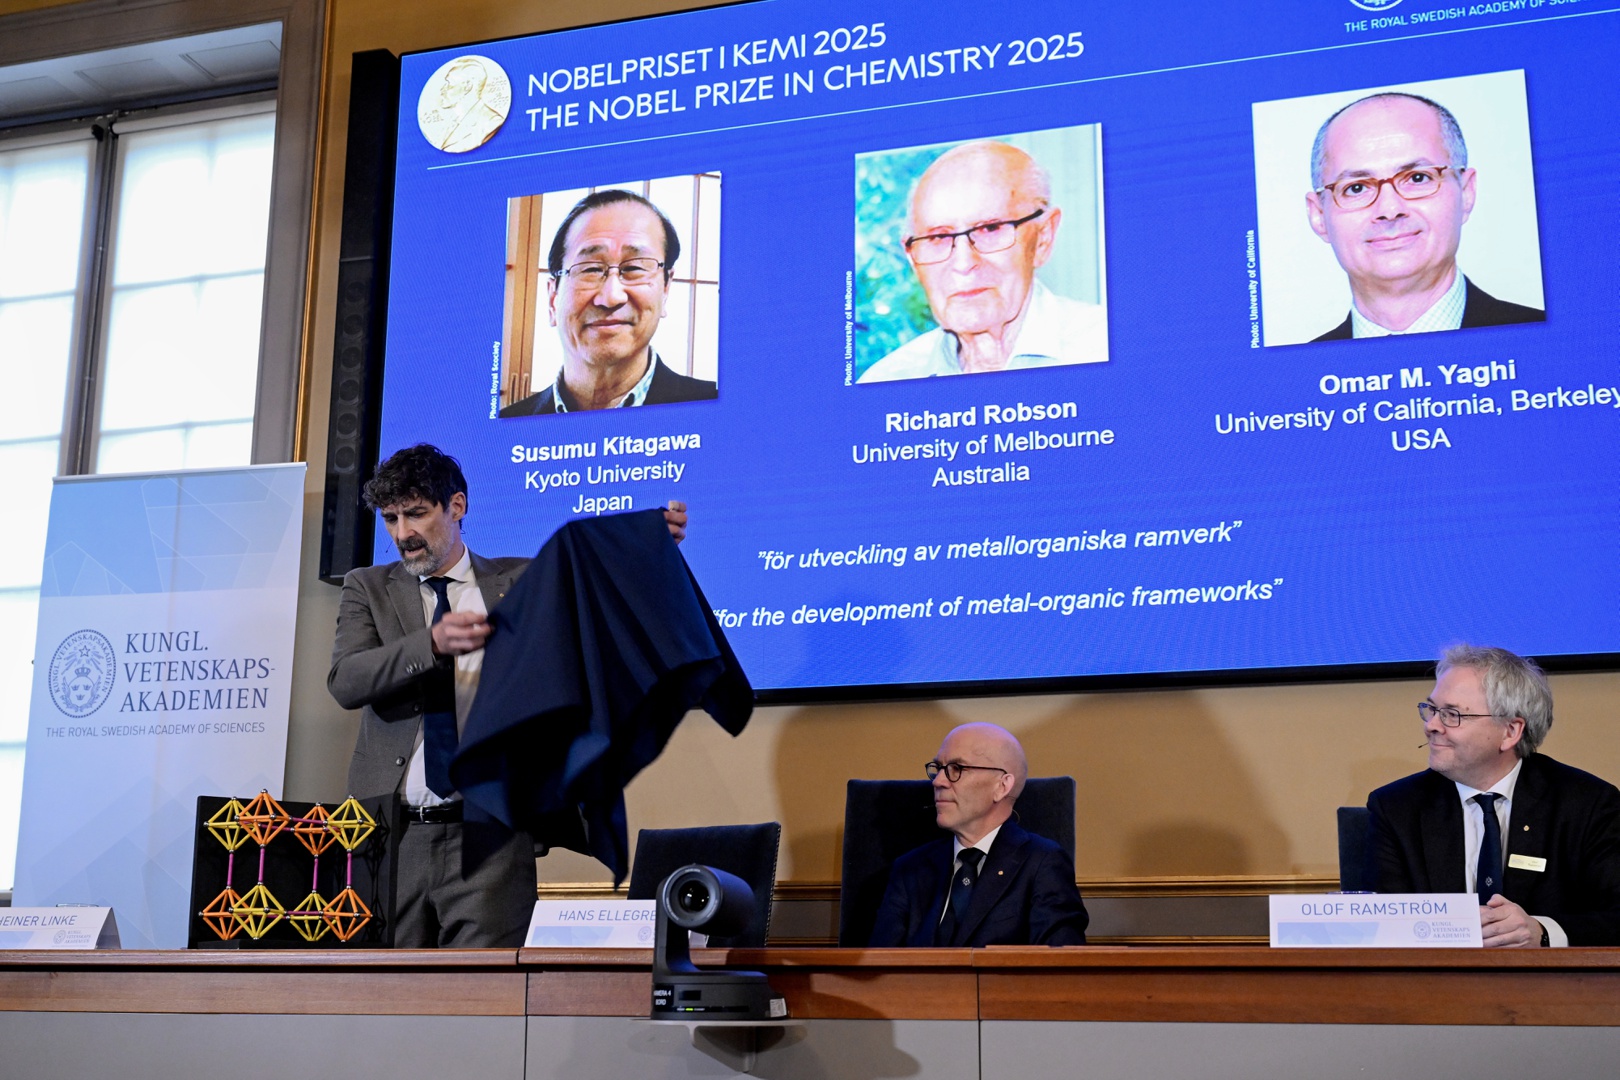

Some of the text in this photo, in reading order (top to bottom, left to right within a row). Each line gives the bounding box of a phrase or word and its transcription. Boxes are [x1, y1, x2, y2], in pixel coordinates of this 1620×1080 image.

[1344, 20, 1368, 32] THE
[1370, 15, 1409, 29] ROYAL
[1410, 7, 1466, 24] SWEDISH
[1468, 0, 1527, 16] ACADEMY
[528, 47, 714, 97] NOBELPRISET
[719, 46, 725, 69] I
[733, 34, 806, 67] KEMI
[813, 22, 887, 56] 2025
[525, 31, 1084, 132] THE NOBEL PRIZE IN CHEMISTRY 2025
[1245, 230, 1260, 349] Photo: University of California
[844, 270, 853, 387] Photo: University of Melbourne
[490, 373, 499, 394] Royal
[1319, 359, 1516, 395] Omar M. Yaghi
[489, 395, 497, 419] Photo:
[885, 401, 1078, 433] Richard Robson
[1215, 384, 1620, 434] University of California, Berkeley
[510, 433, 702, 464] Susumu Kitagawa
[852, 429, 1115, 464] University of Melbourne
[1391, 427, 1452, 452] USA
[525, 460, 686, 493] Kyoto University
[931, 462, 1031, 488] Australia
[572, 494, 633, 516] Japan
[799, 543, 908, 568] utveckling
[913, 544, 942, 562] av
[946, 529, 1128, 559] metallorganiska
[1134, 520, 1243, 548] ramverk”
[751, 606, 785, 627] the
[791, 597, 934, 627] development
[938, 595, 964, 617] of
[966, 587, 1126, 616] metal-organic
[1131, 577, 1284, 607] frameworks”
[125, 631, 209, 654] KUNGL.
[124, 657, 277, 683] VETENSKAPS-
[119, 687, 270, 713] AKADEMIEN
[46, 722, 265, 738] THE ROYAL SWEDISH ACADEMY OF SCIENCES
[41, 914, 78, 926] LINKE
[558, 909, 656, 921] HANS ELLEGRE
[1301, 899, 1448, 916] OLOF RAMSTRÖM
